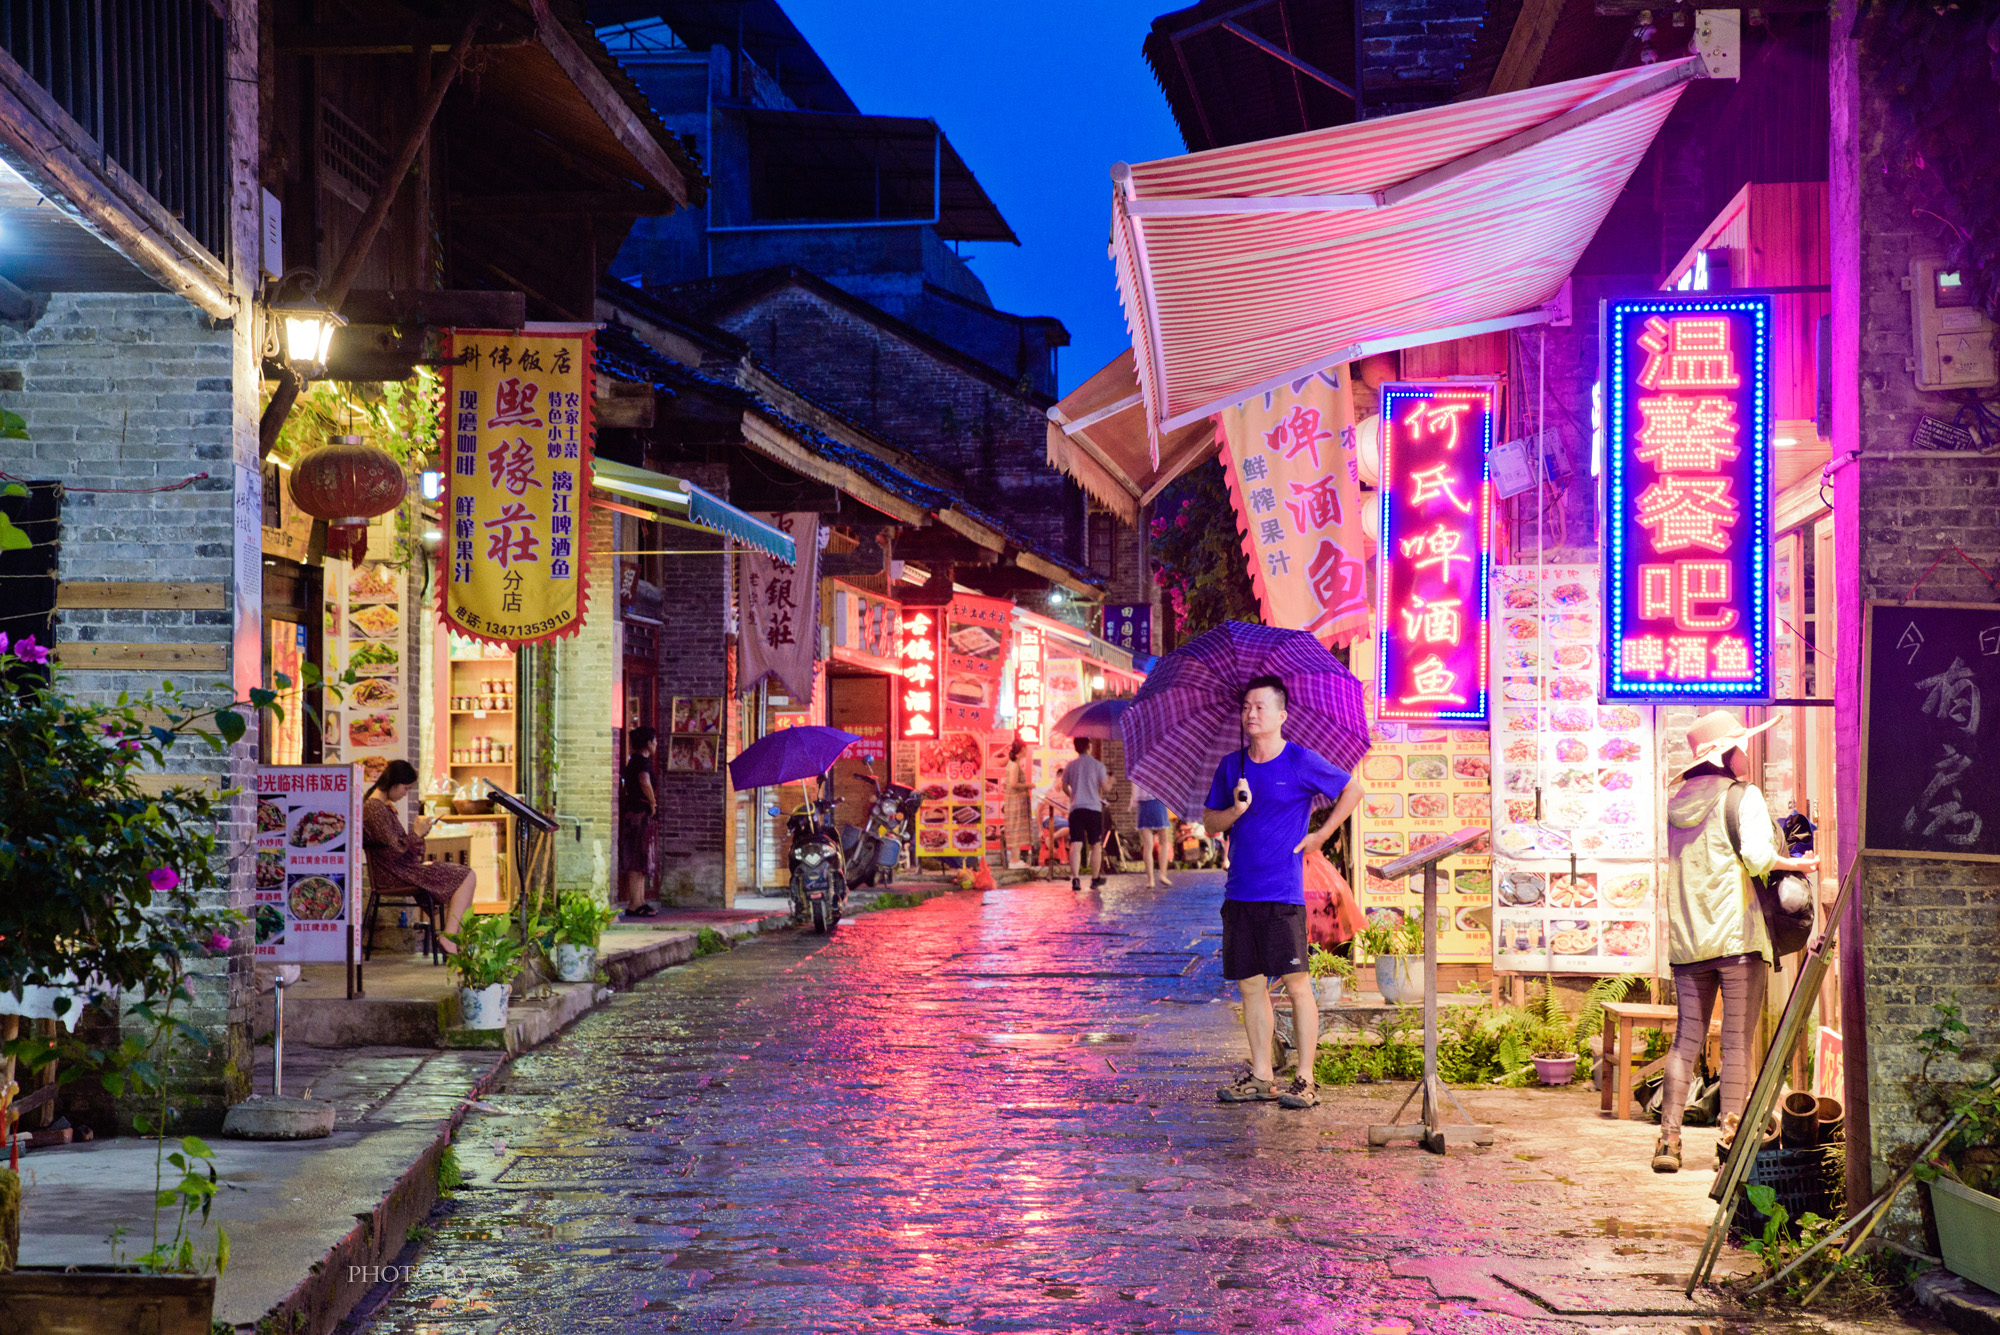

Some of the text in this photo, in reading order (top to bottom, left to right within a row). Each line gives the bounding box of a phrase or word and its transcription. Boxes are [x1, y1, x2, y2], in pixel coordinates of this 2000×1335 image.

[459, 343, 571, 374] 科伟饭店
[456, 390, 477, 476] 现磨咖啡
[547, 391, 563, 459] 特色小炒
[564, 392, 579, 459] 农家土菜
[1243, 454, 1291, 576] 鲜榨果汁
[1634, 316, 1740, 631] 温馨餐吧
[454, 496, 475, 583] 鲜榨果汁
[550, 471, 573, 579] 漓江啤酒鱼
[1264, 406, 1368, 632] 啤酒鱼
[1400, 401, 1472, 704] 何氏啤酒鱼
[485, 610, 570, 636] 13471353910
[502, 570, 523, 612] 分店
[1622, 635, 1753, 680] 啤酒鱼
